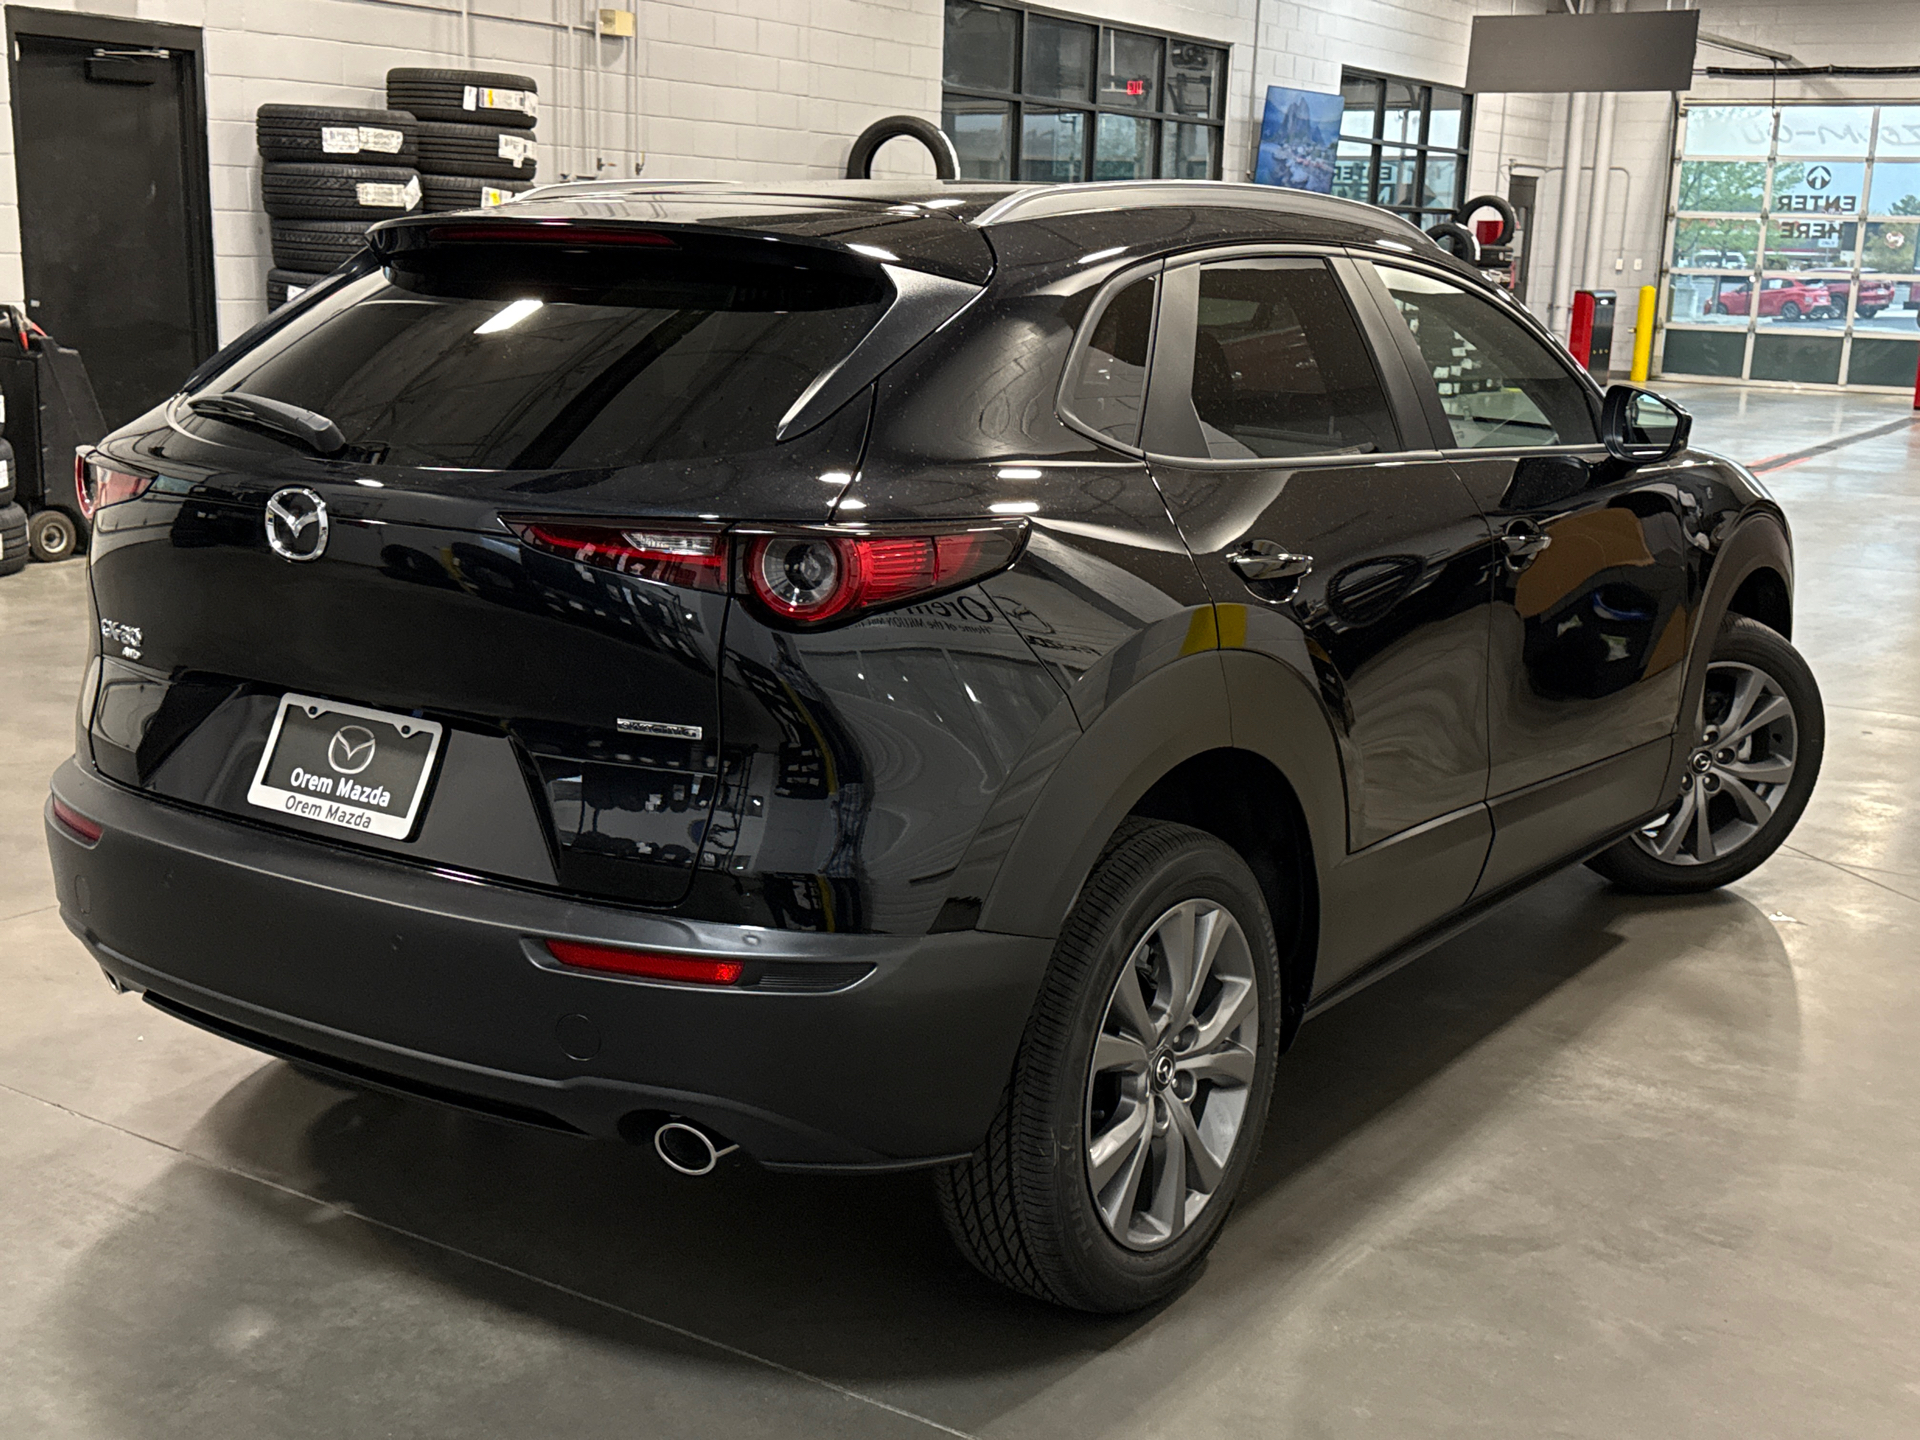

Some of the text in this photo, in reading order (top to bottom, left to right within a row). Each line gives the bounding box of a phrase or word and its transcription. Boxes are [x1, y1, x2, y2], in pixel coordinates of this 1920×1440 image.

[290, 767, 391, 807] Orem Mazda
[285, 794, 372, 829] Orem Mazda
